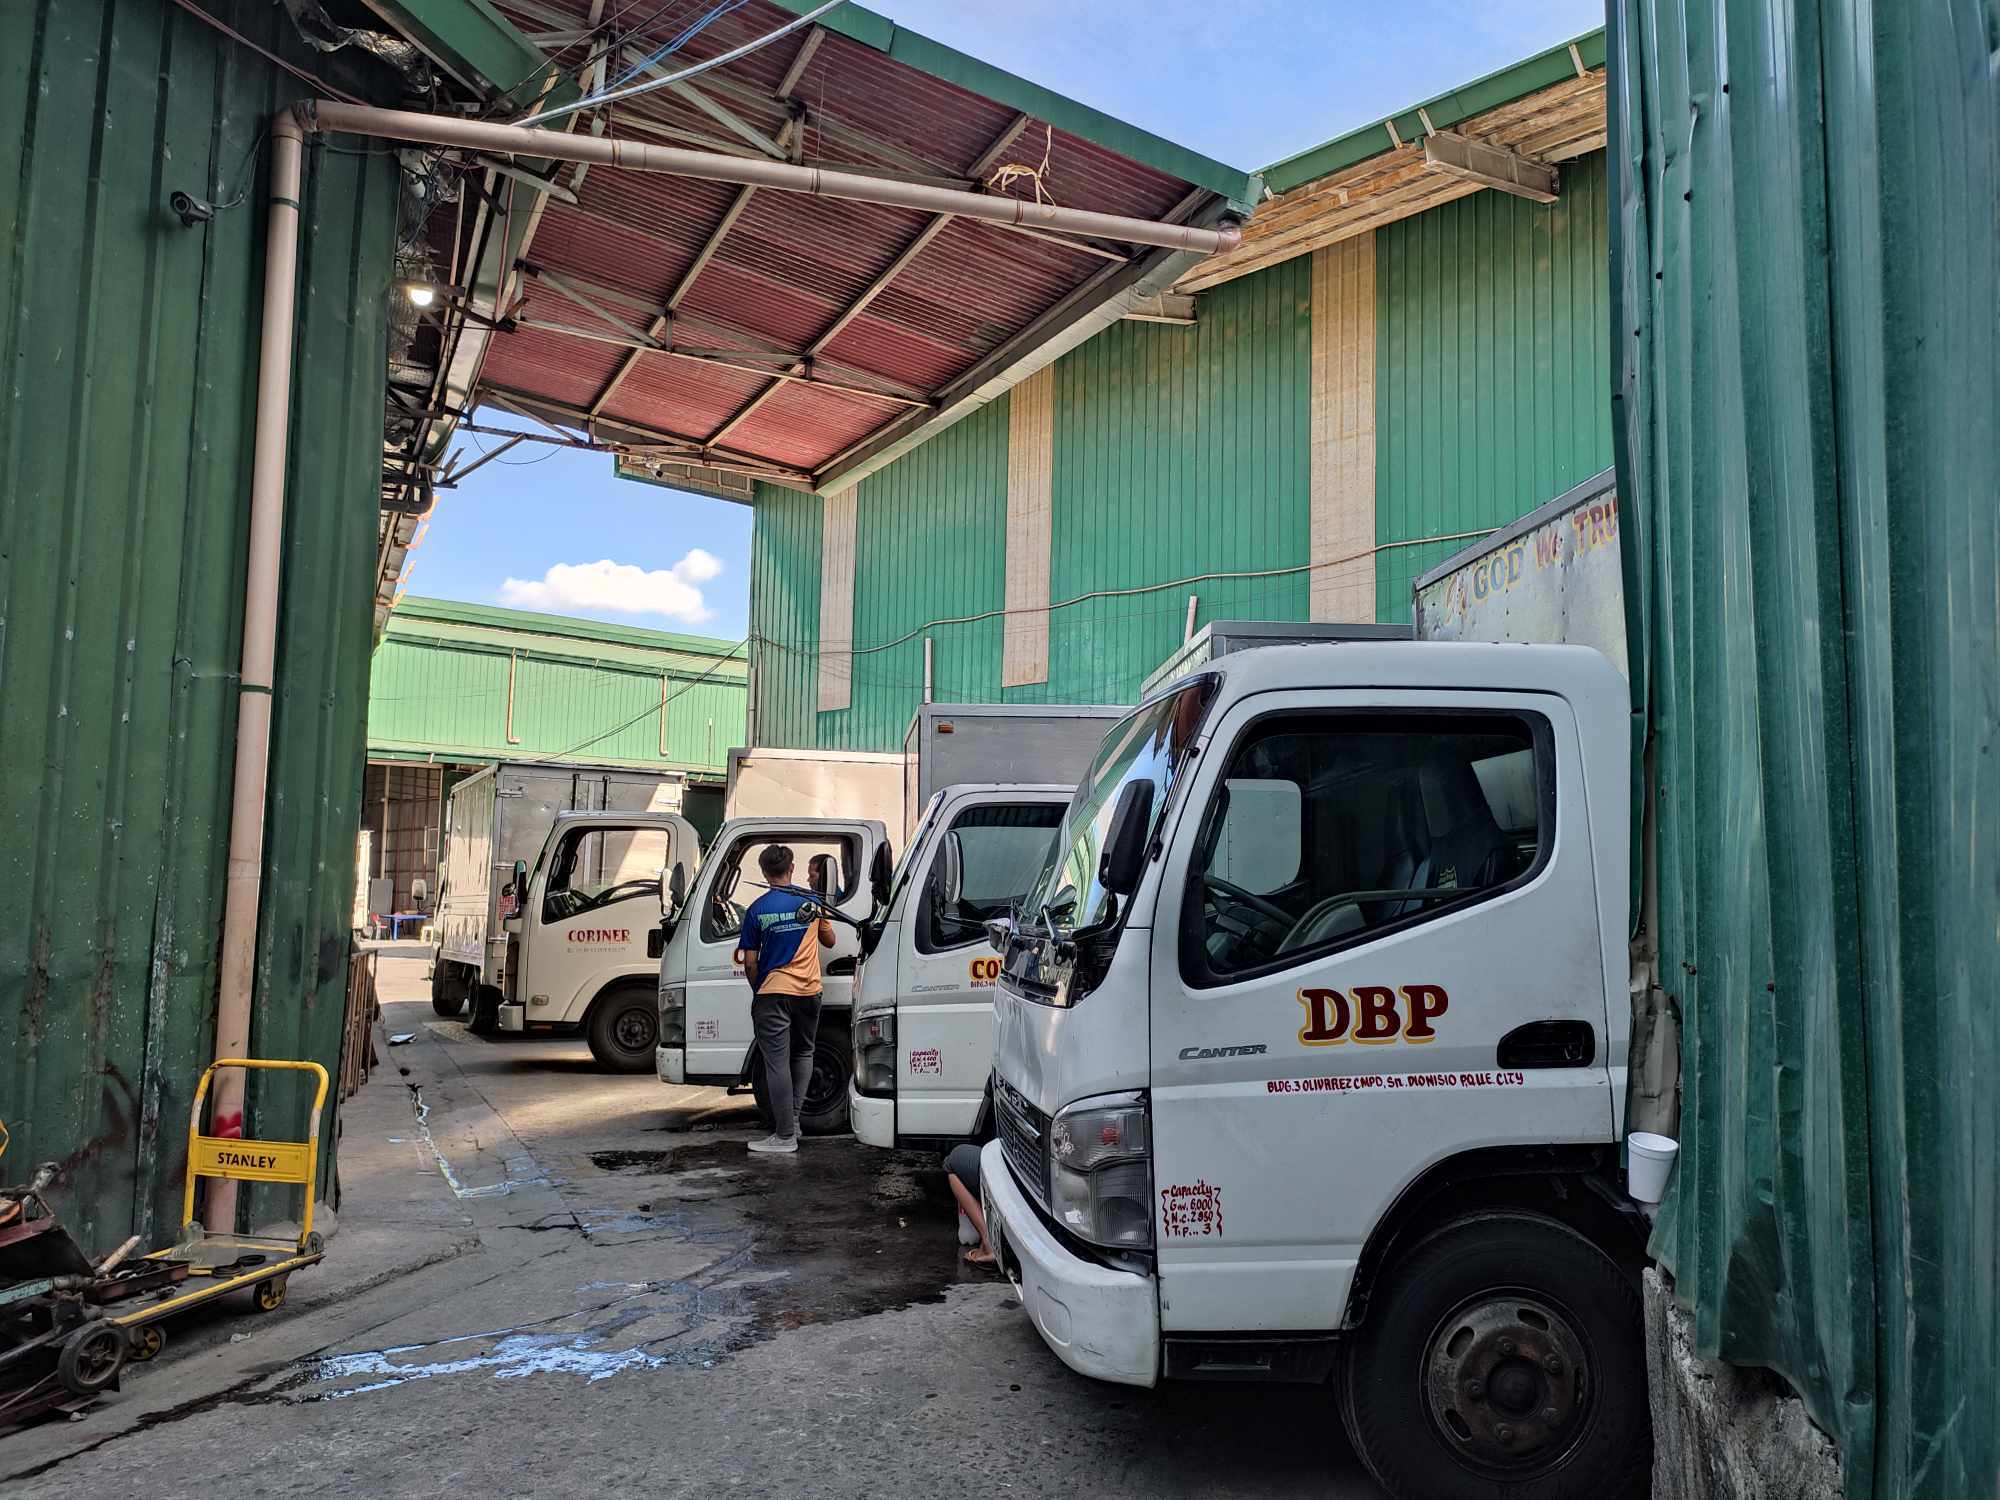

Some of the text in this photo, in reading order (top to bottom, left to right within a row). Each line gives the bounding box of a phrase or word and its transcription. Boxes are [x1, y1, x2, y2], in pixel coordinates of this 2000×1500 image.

[1473, 546, 1525, 602] GOD
[969, 957, 1003, 980] CO
[1297, 985, 1448, 1047] DBP
[1179, 1043, 1268, 1060] CANTER
[1267, 1080, 1300, 1093] BLDG.3
[1408, 1074, 1457, 1087] DIONISIO
[1496, 1072, 1524, 1086] CITY
[217, 1152, 277, 1169] STANLEY
